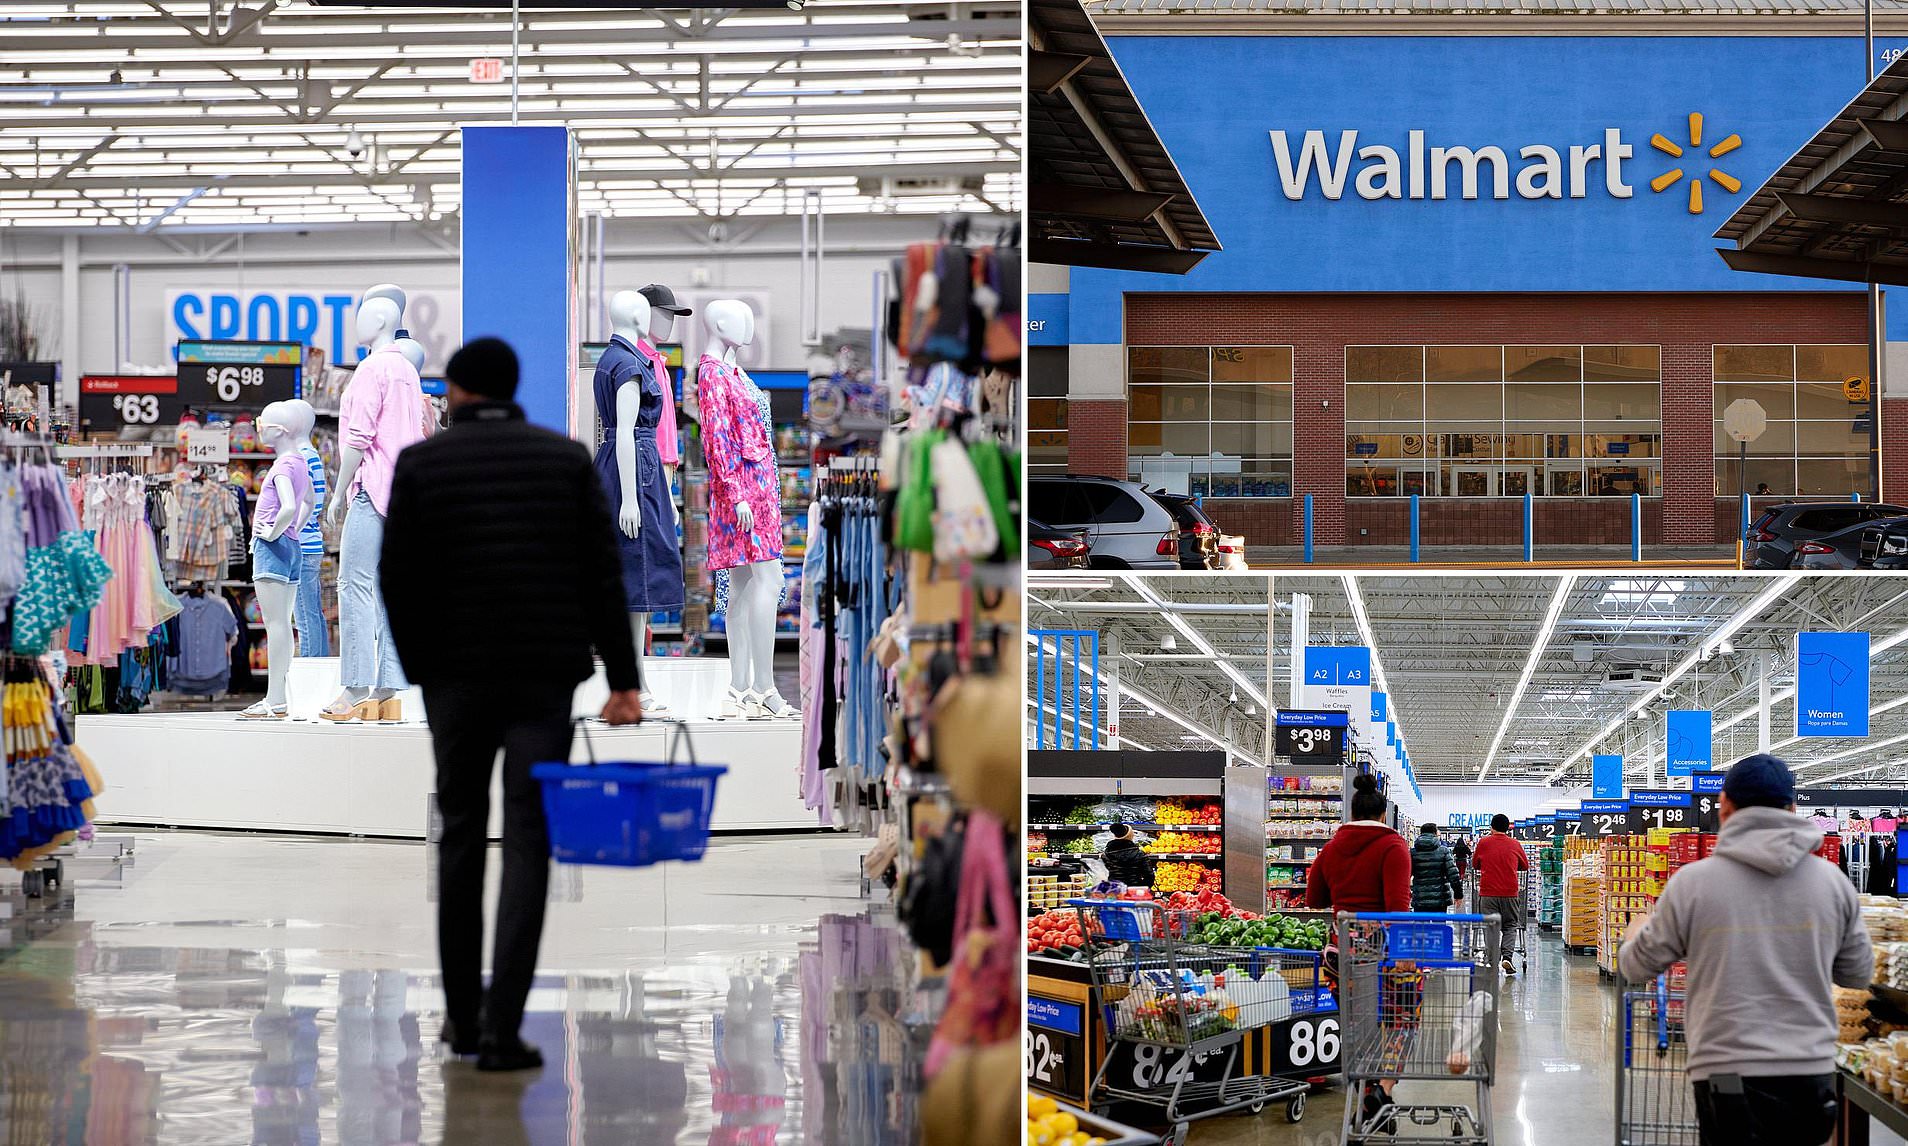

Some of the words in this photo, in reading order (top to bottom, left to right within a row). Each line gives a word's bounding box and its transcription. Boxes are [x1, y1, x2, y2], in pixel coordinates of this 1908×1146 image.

[1268, 128, 1633, 200] Walmart
[172, 293, 373, 366] SPORT
[206, 367, 264, 402] $698
[113, 394, 159, 424] $63
[1313, 670, 1328, 679] A2
[1347, 670, 1362, 679] A3
[1808, 709, 1844, 719] Women
[1290, 728, 1331, 752] $398
[1699, 777, 1725, 786] Everyd
[1797, 793, 1810, 801] Plus
[1592, 814, 1626, 834] $246
[1642, 808, 1683, 828] $198
[1541, 824, 1555, 838] $2
[1566, 821, 1582, 836] $7
[1037, 1002, 1046, 1013] Low
[1046, 1004, 1060, 1016] Price
